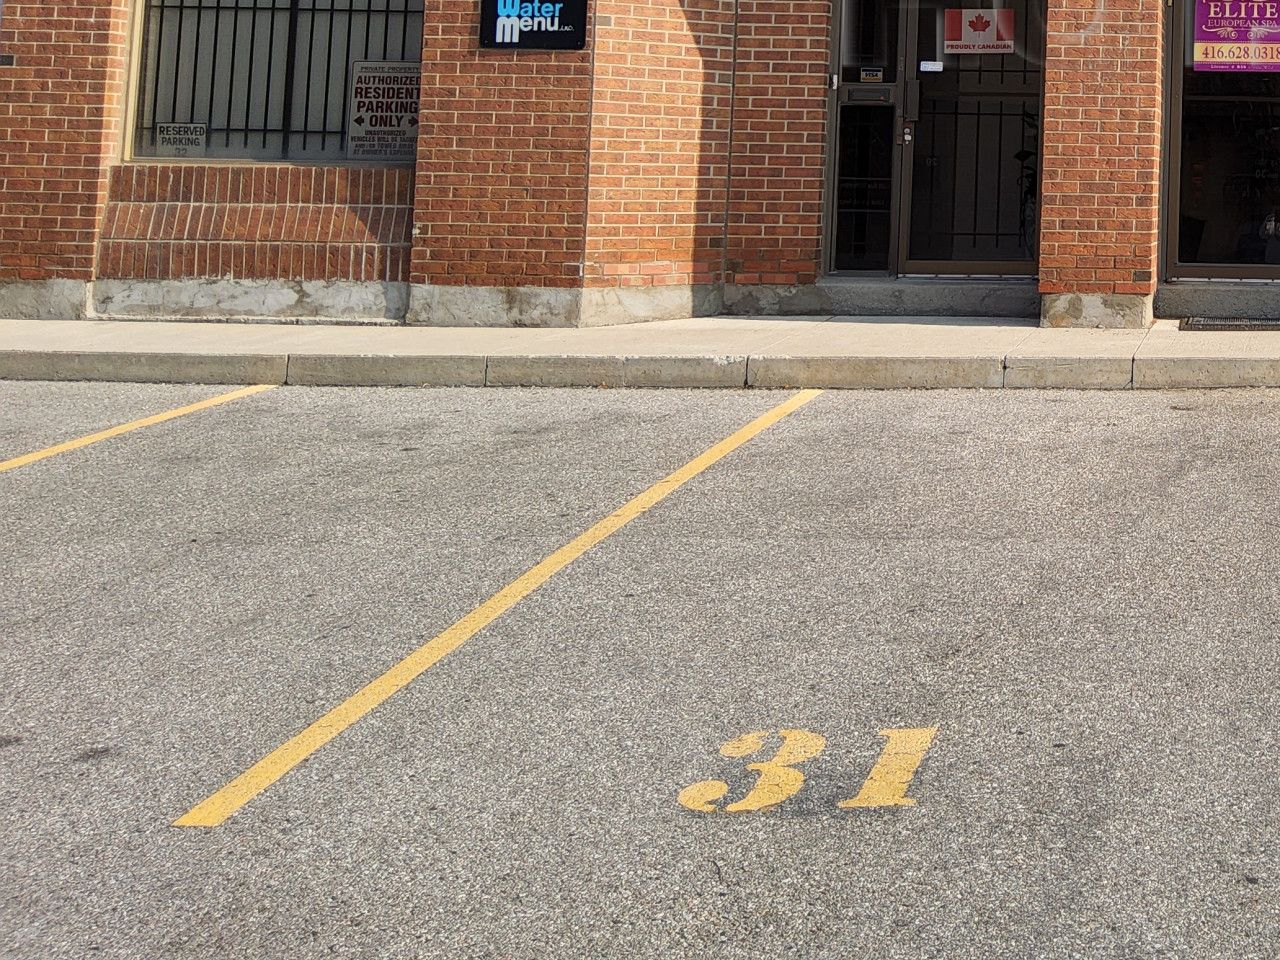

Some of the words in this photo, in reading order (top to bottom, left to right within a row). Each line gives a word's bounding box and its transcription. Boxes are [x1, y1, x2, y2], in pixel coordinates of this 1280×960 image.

[1208, 2, 1279, 19] ELITE
[356, 75, 421, 86] AUTHORIZED
[354, 86, 421, 100] RESIDENT
[356, 100, 418, 114] PARKING
[369, 114, 404, 128] ONLY
[159, 125, 205, 136] RESERVED
[161, 136, 200, 146] PARKING
[677, 727, 939, 813] 31
